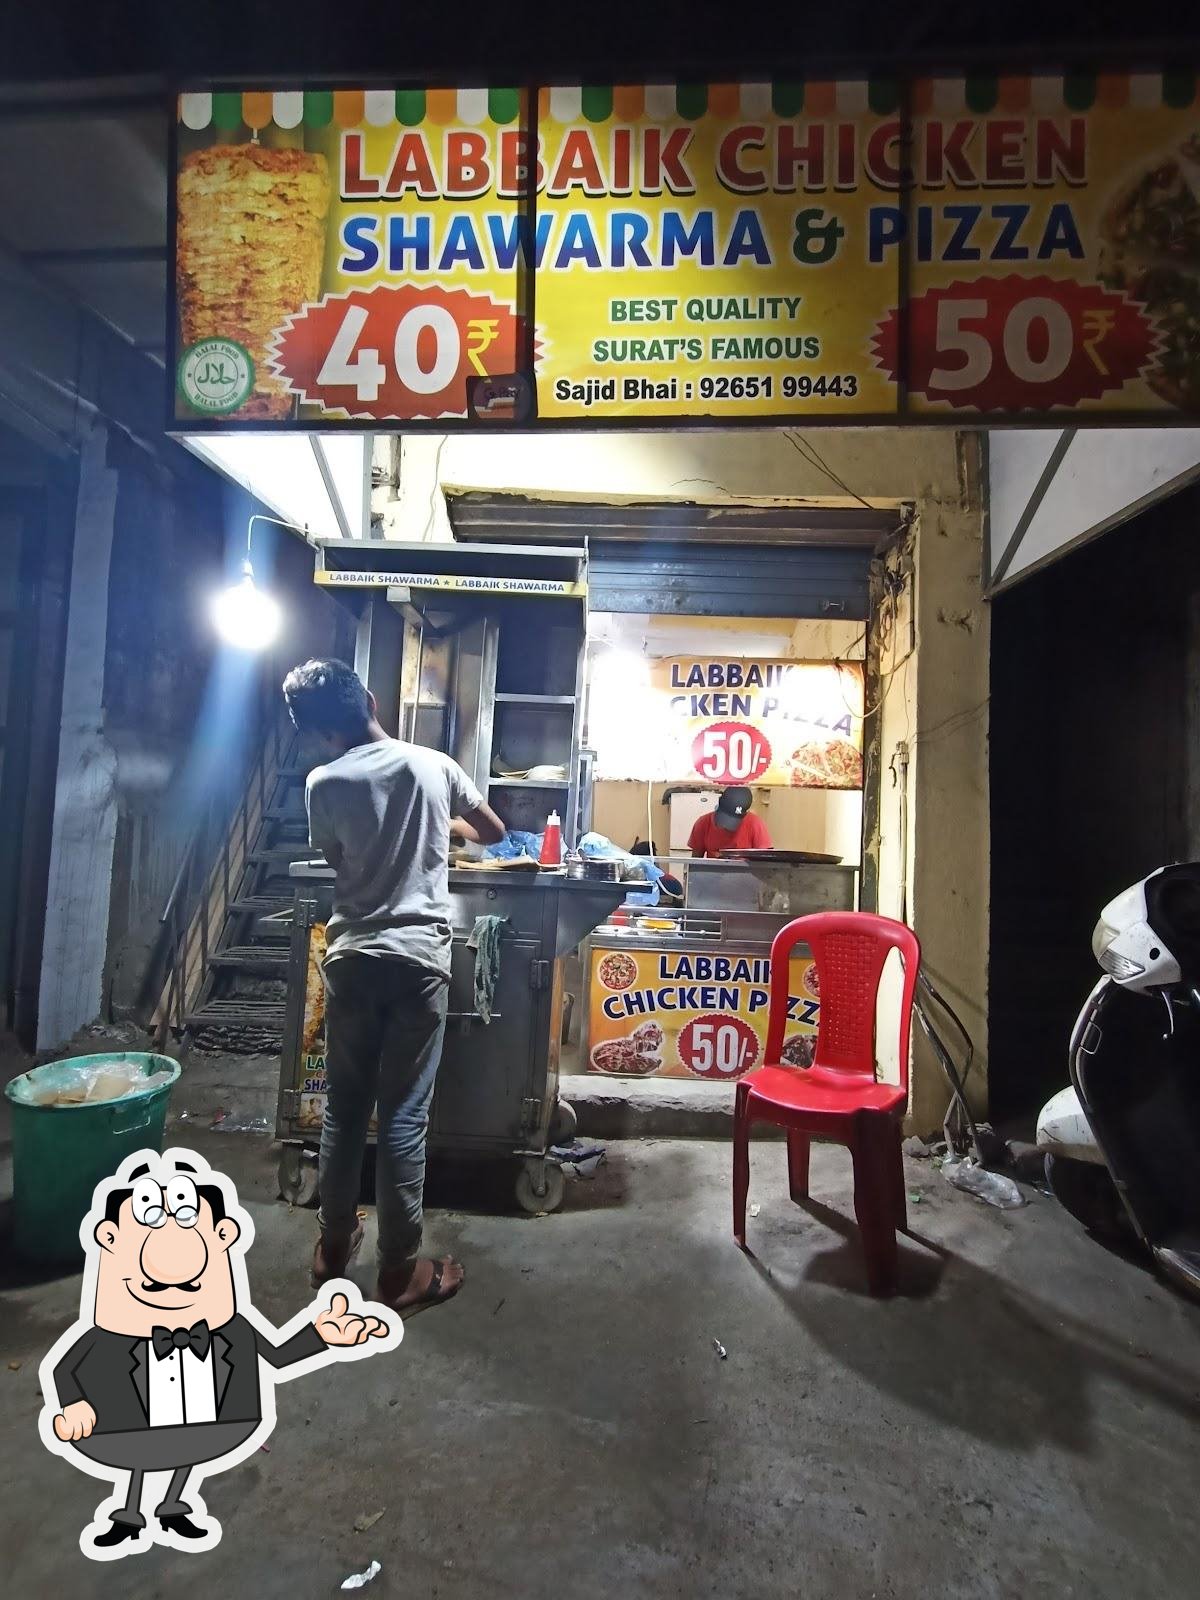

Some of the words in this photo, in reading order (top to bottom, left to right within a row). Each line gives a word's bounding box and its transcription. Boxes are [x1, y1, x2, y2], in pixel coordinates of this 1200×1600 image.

[342, 127, 697, 200] LABBAIK
[717, 118, 1088, 194] CHICKEN
[341, 210, 773, 273] SHAWARMA
[793, 208, 845, 264] &
[869, 204, 1086, 263] PIZZA
[611, 299, 678, 322] BEST
[686, 297, 802, 322] QUALITY
[593, 338, 702, 362] SURAT'S
[711, 337, 820, 360] FAMOUS
[556, 379, 615, 405] Sajid
[624, 379, 677, 400] Bhai
[700, 376, 772, 399] 92651
[783, 376, 858, 398] 99443
[329, 573, 375, 583] LABBAIK
[377, 575, 440, 586] SHAWARMA
[455, 579, 500, 589] LABBAIK
[502, 581, 565, 592] SHAWARMA
[703, 731, 767, 779] 50/-
[603, 986, 739, 1018] CHICKEN
[748, 989, 821, 1027] PZZ
[691, 1024, 753, 1073] 50/-
